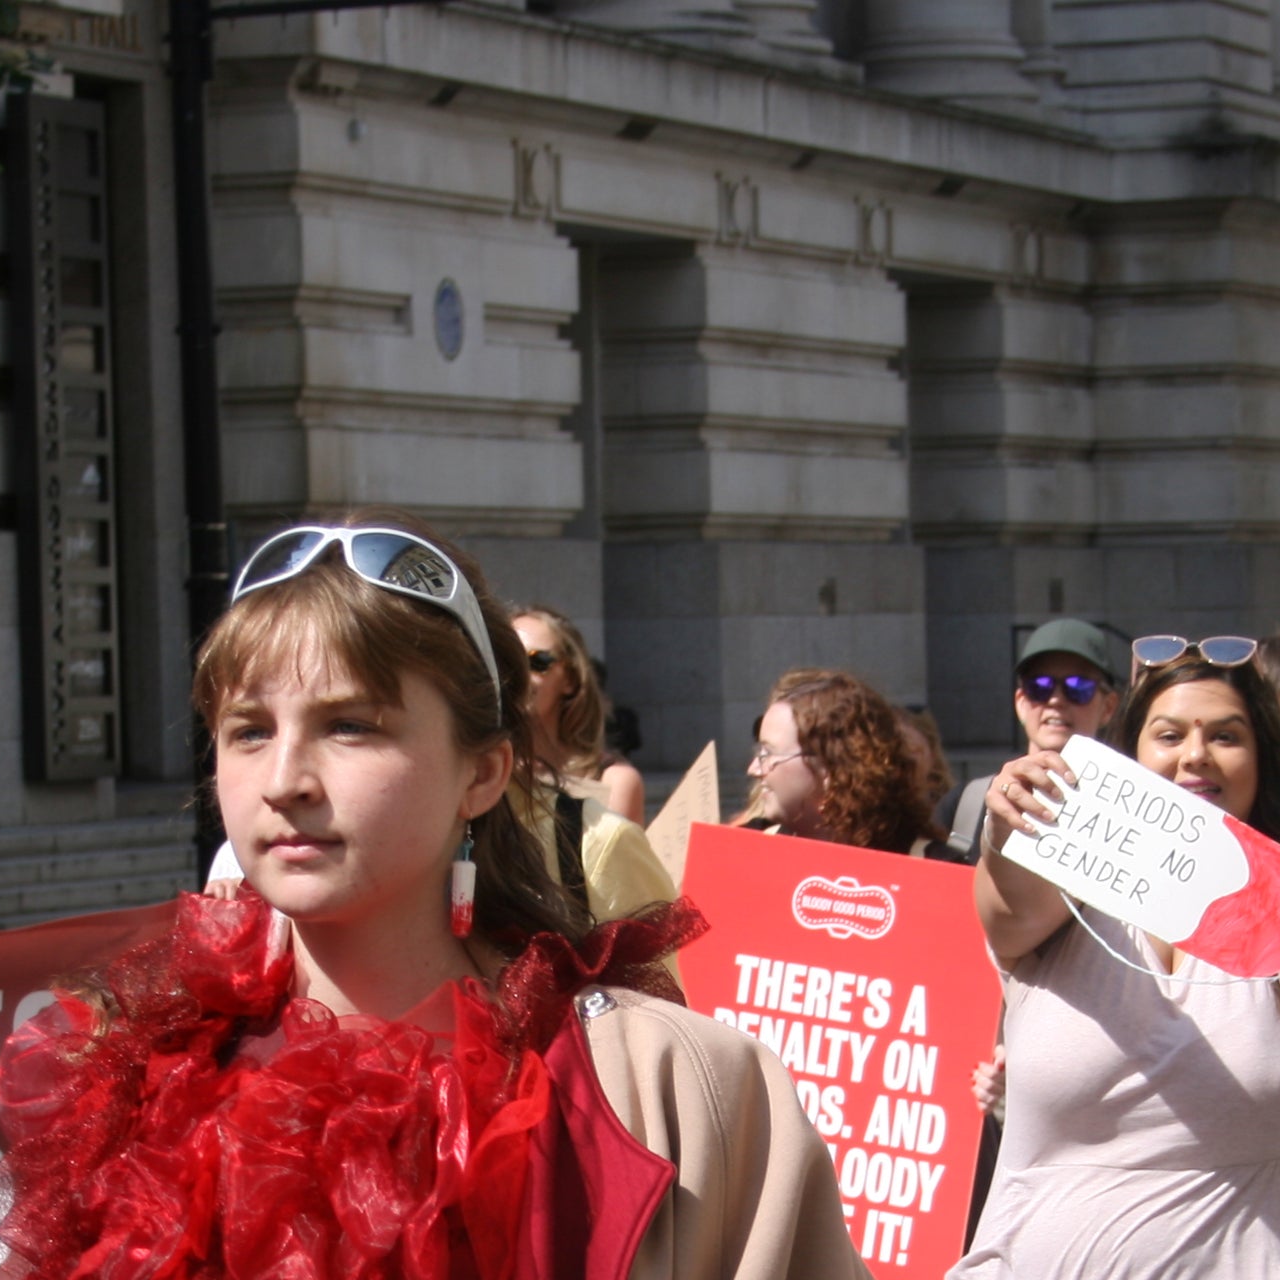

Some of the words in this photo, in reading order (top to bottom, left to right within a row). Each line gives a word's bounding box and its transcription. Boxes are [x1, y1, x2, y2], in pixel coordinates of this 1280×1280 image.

[1075, 760, 1206, 843] PERIODS
[1035, 832, 1151, 905] GENDER
[1054, 800, 1141, 856] HAVE
[1160, 849, 1197, 883] NO
[735, 953, 893, 1029] THERE'S
[899, 984, 927, 1037] A
[882, 1039, 939, 1096] ON
[863, 1094, 947, 1155] AND
[861, 1209, 914, 1266] IT!
